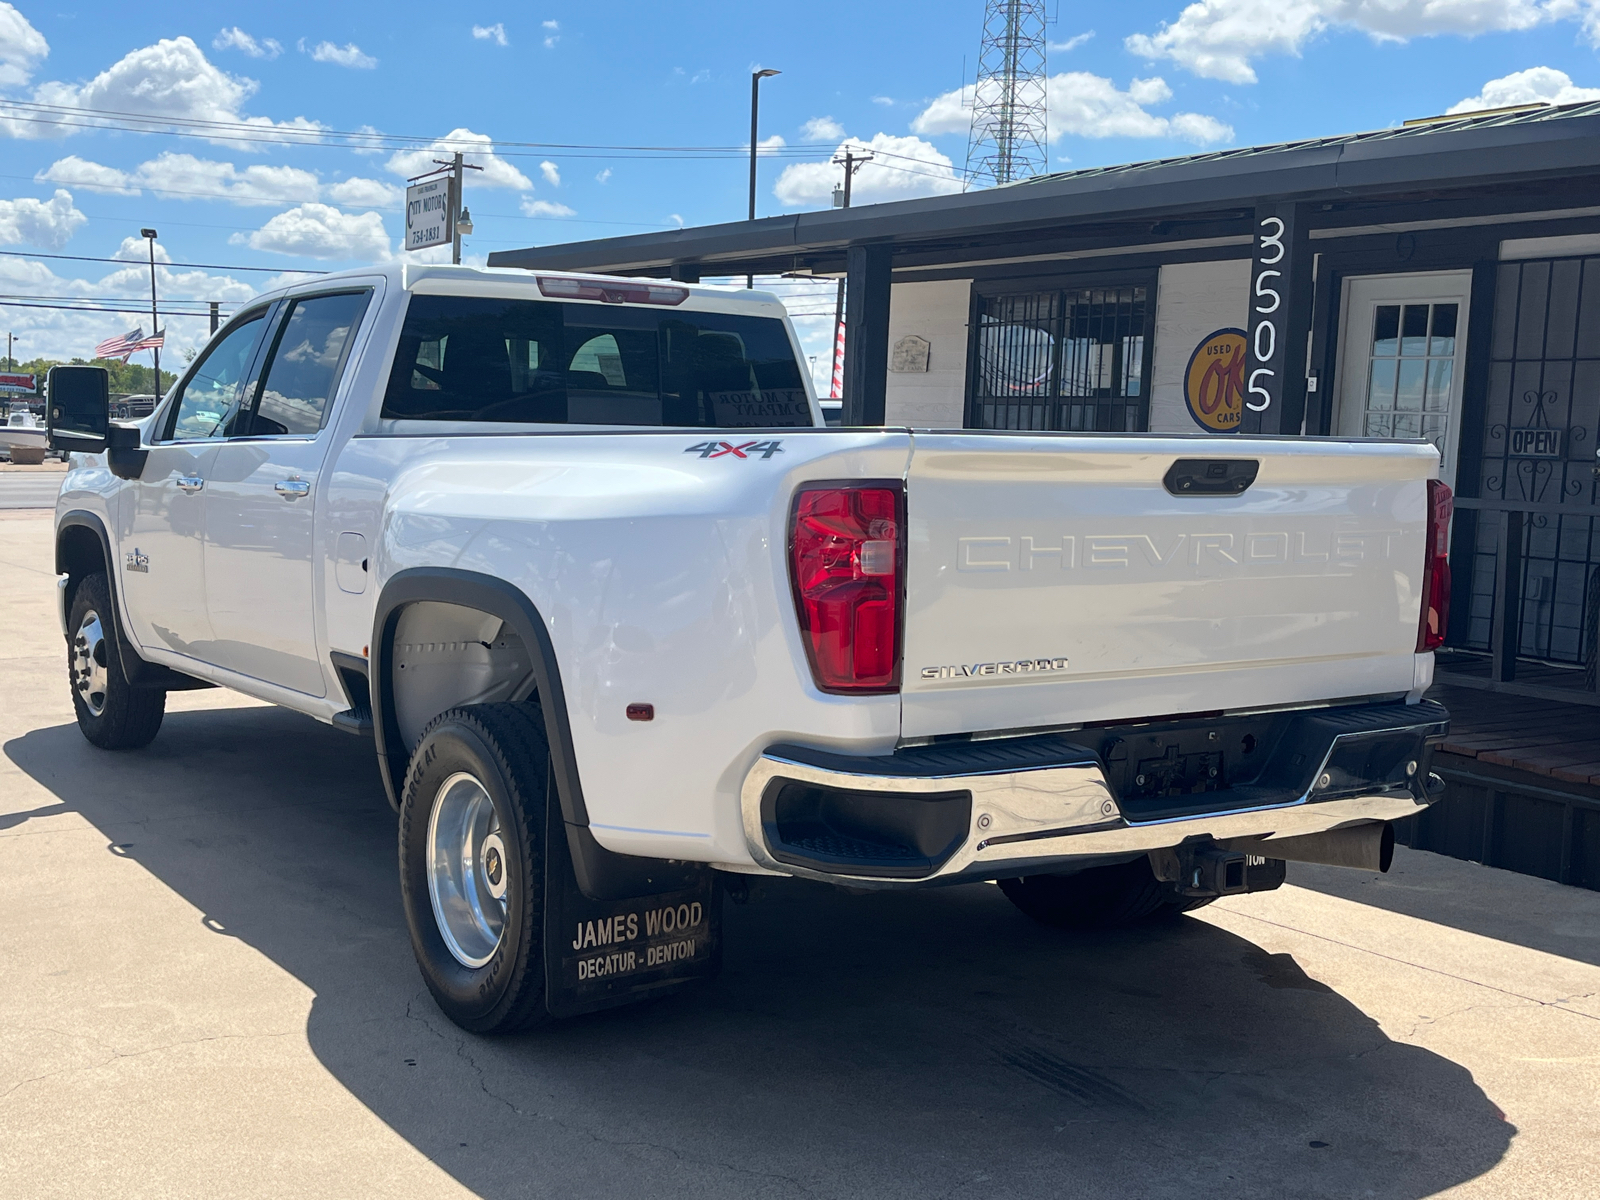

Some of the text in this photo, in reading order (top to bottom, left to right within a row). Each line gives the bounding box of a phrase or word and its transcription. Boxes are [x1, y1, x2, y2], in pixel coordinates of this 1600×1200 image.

[407, 192, 447, 229] CITY MOTORS
[412, 226, 440, 244] 754-1831
[1246, 217, 1285, 412] 3505
[1207, 344, 1231, 356] USED
[1216, 412, 1241, 423] CARS
[1512, 430, 1558, 455] OPEN
[957, 529, 1404, 573] CHEVROLET
[921, 657, 1069, 680] SILVERADO
[572, 901, 703, 951] JAMES WOOD
[578, 951, 636, 980] DECATUR
[647, 939, 695, 967] DENTON
